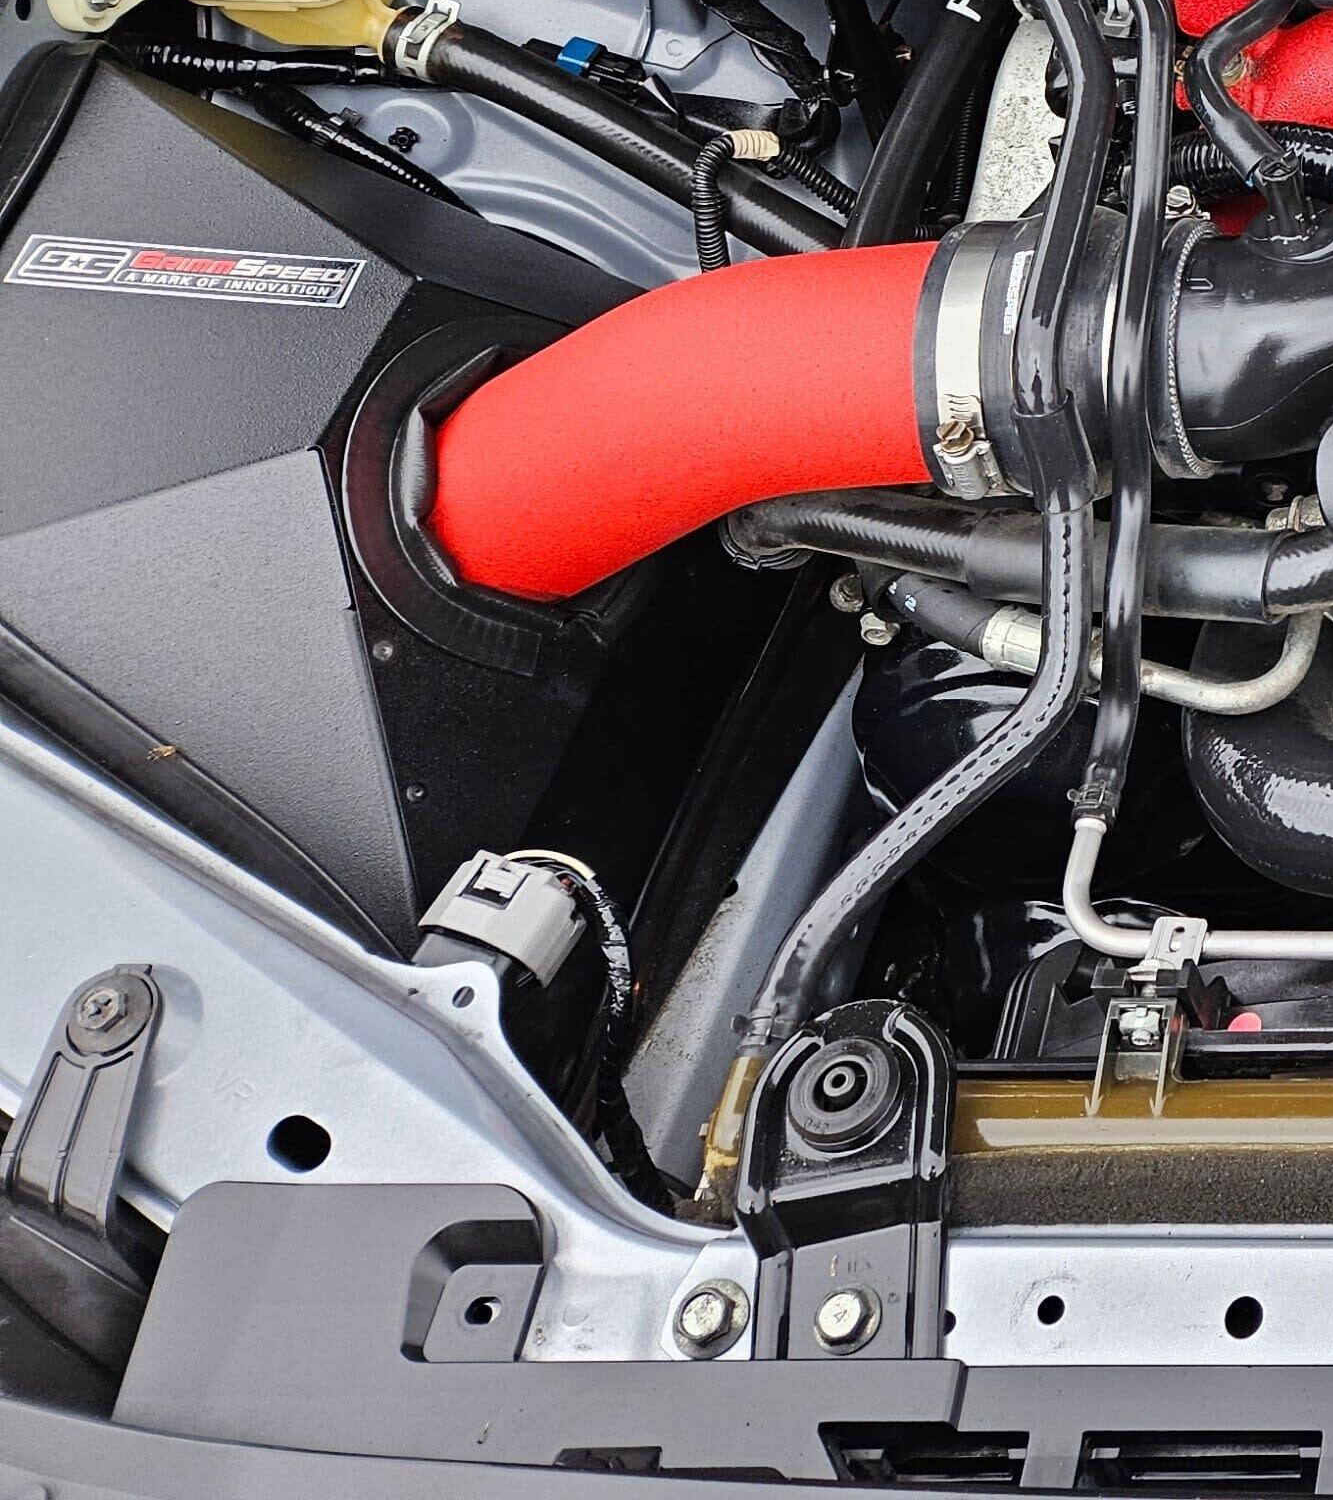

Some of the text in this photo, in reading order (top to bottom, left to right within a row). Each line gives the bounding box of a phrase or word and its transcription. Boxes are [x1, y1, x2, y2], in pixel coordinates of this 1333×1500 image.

[122, 272, 333, 297] A MARK OF INNOVATION
